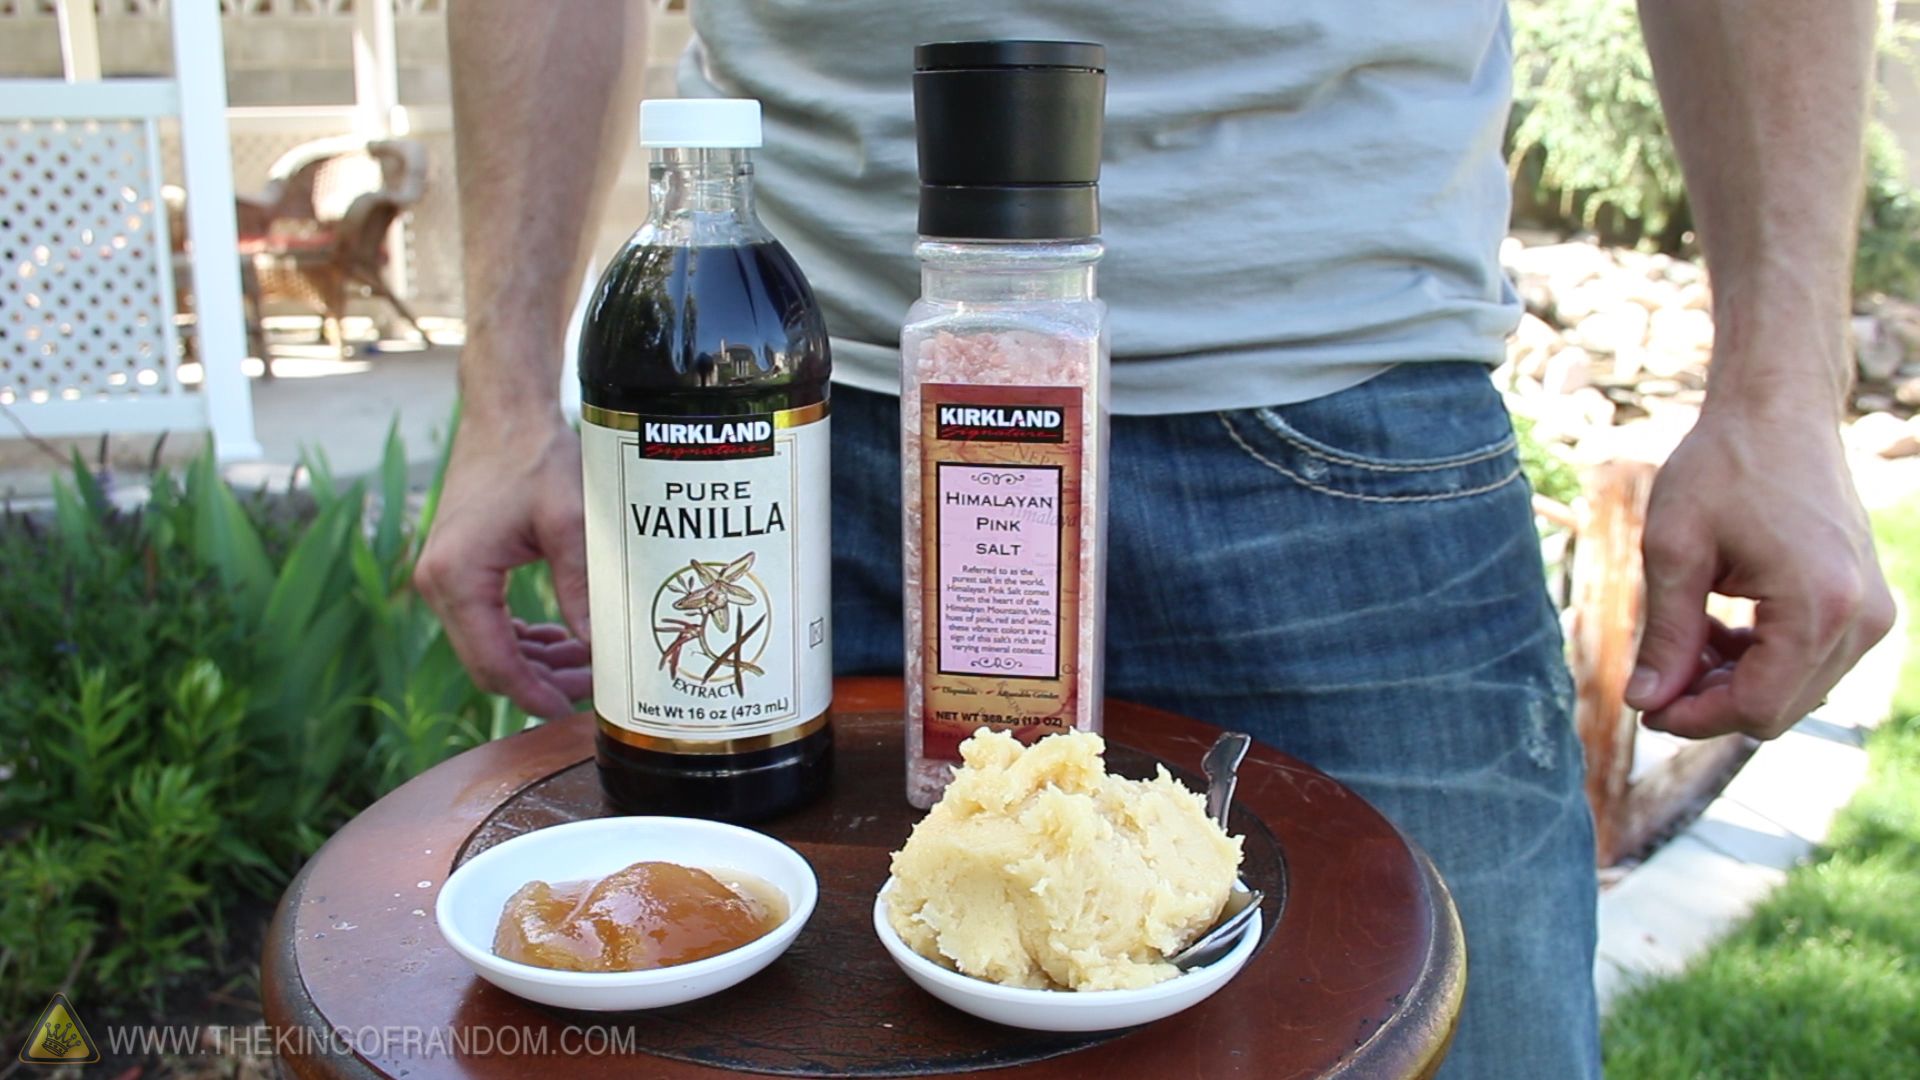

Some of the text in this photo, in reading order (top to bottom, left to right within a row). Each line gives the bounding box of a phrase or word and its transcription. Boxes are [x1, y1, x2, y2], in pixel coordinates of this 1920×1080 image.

[941, 408, 1060, 428] KIRKLAND
[645, 421, 770, 443] KIRKLAND
[941, 426, 1058, 440] Signature
[645, 444, 770, 458] Signature
[666, 481, 751, 501] PURE
[946, 492, 1052, 508] HIMALAYAN
[631, 502, 785, 538] VANILLA
[977, 517, 1020, 531] PINK
[976, 544, 1021, 555] SALT
[962, 565, 996, 574] Referred
[1021, 568, 1033, 576] the
[947, 585, 986, 594] Himalayan
[988, 586, 1004, 594] Pink
[1008, 587, 1021, 595] Salt
[952, 644, 979, 653] varying
[672, 678, 735, 698] EXTRACT
[638, 698, 788, 720] Net Wt 16 oz (473 mL)
[936, 711, 1062, 728] NET WT 368.5g (13 OZ)
